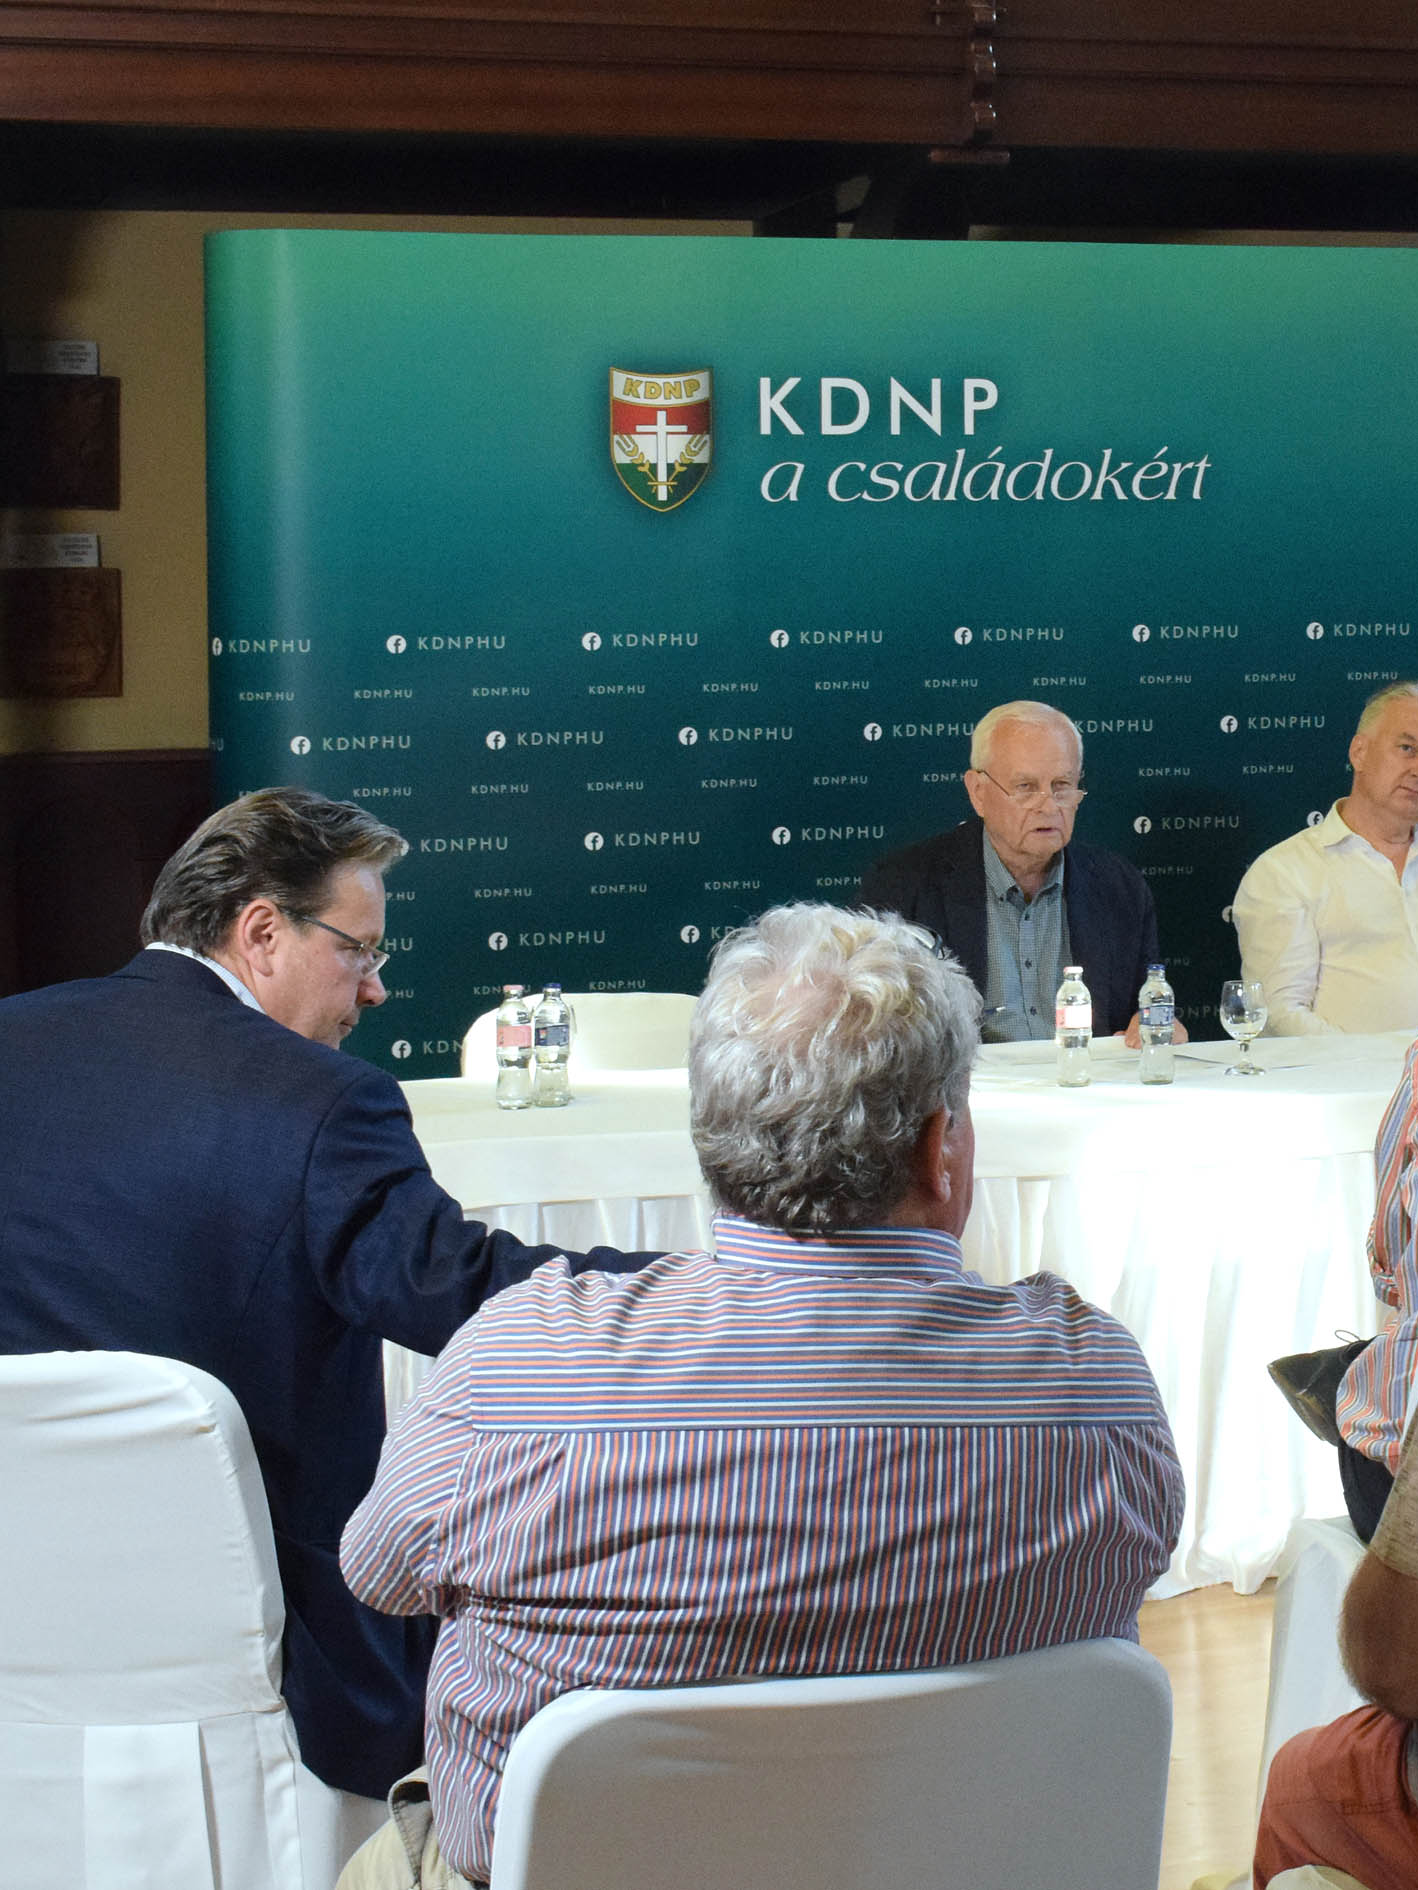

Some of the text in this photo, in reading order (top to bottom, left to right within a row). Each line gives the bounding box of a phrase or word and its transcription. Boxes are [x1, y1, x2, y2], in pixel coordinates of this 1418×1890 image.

[622, 377, 701, 400] KDNP
[759, 377, 999, 436] KDNP
[760, 445, 1213, 502] a családokért
[799, 630, 883, 645] KDNPHU
[982, 627, 1065, 642] KDNPHU
[1160, 625, 1239, 639] KDNPHU
[1333, 622, 1411, 637] KDNPHU
[229, 639, 311, 653] KDNPHU
[417, 635, 506, 651] KDNPHU
[612, 632, 699, 648] KDNPHU
[893, 723, 974, 738] KDNPHU
[1247, 715, 1326, 730] KDNPHU
[516, 730, 604, 746] KDNPHU
[708, 727, 793, 742] KDNPHU
[322, 735, 411, 751] KDNPHU
[1161, 815, 1240, 830] KDNPHU
[614, 831, 701, 847] KDNPHU
[801, 825, 885, 841] KDNPHU
[420, 836, 509, 853] KDNPHU
[519, 930, 606, 947] KDNPHU
